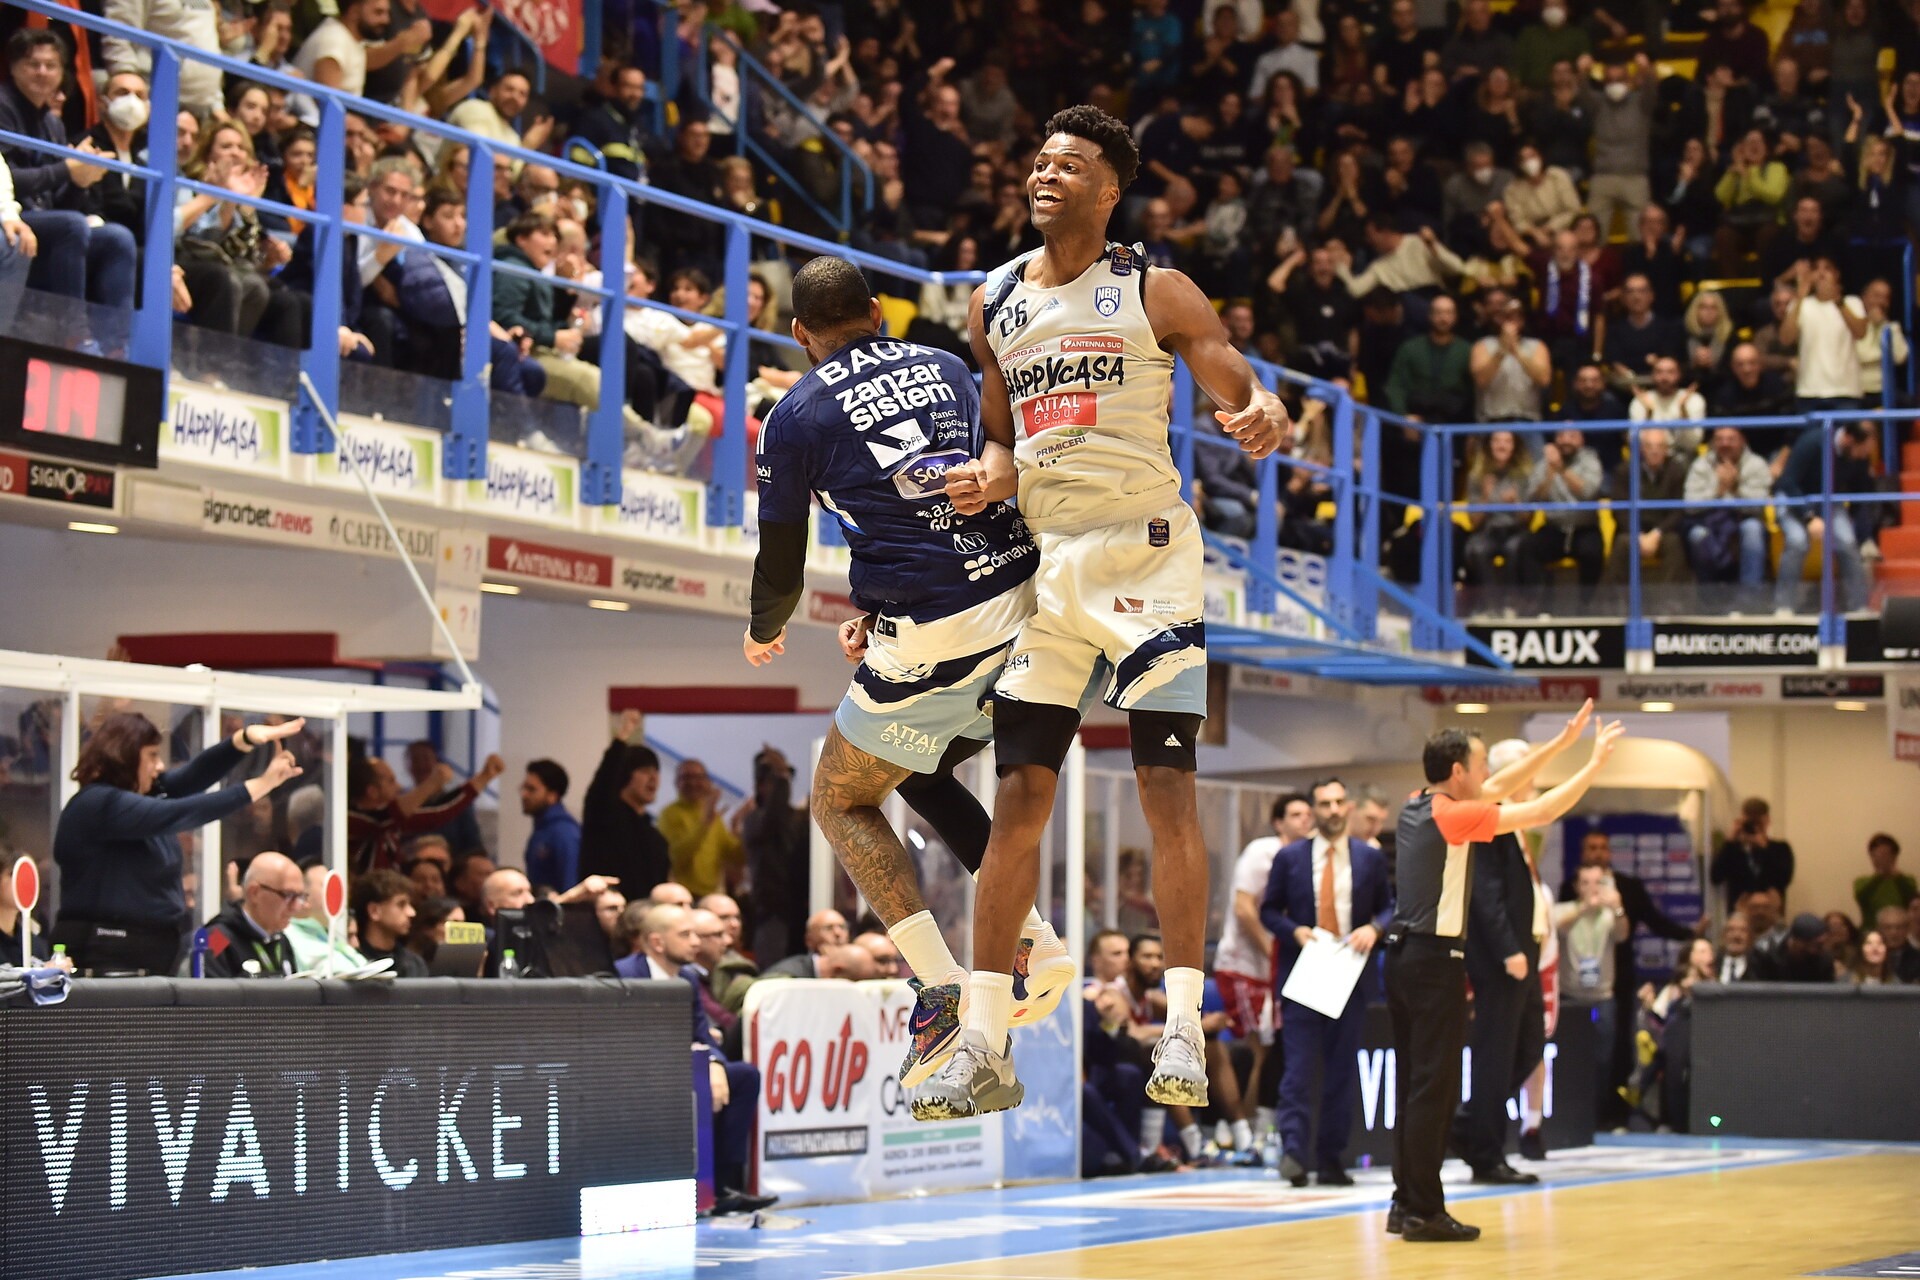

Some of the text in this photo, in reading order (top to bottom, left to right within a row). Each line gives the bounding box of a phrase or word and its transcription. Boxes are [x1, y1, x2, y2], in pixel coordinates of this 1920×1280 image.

[1096, 287, 1119, 303] NBB
[999, 299, 1028, 338] 26
[1071, 340, 1122, 349] ANTENNA SUD
[815, 341, 934, 387] BAUX
[834, 363, 942, 414] zanzar
[849, 381, 957, 432] sistem
[1033, 394, 1080, 416] ATTAL
[1034, 408, 1080, 425] GROUP
[1036, 436, 1087, 458] PRIMICERI
[1491, 629, 1601, 664] BAUX
[1654, 633, 1820, 655] BAUXCUCINE.COM
[880, 733, 937, 756] GROUP
[884, 721, 938, 749] ATTAL
[765, 1012, 868, 1114] GO UP
[26, 1062, 572, 1217] VIVATICKET
